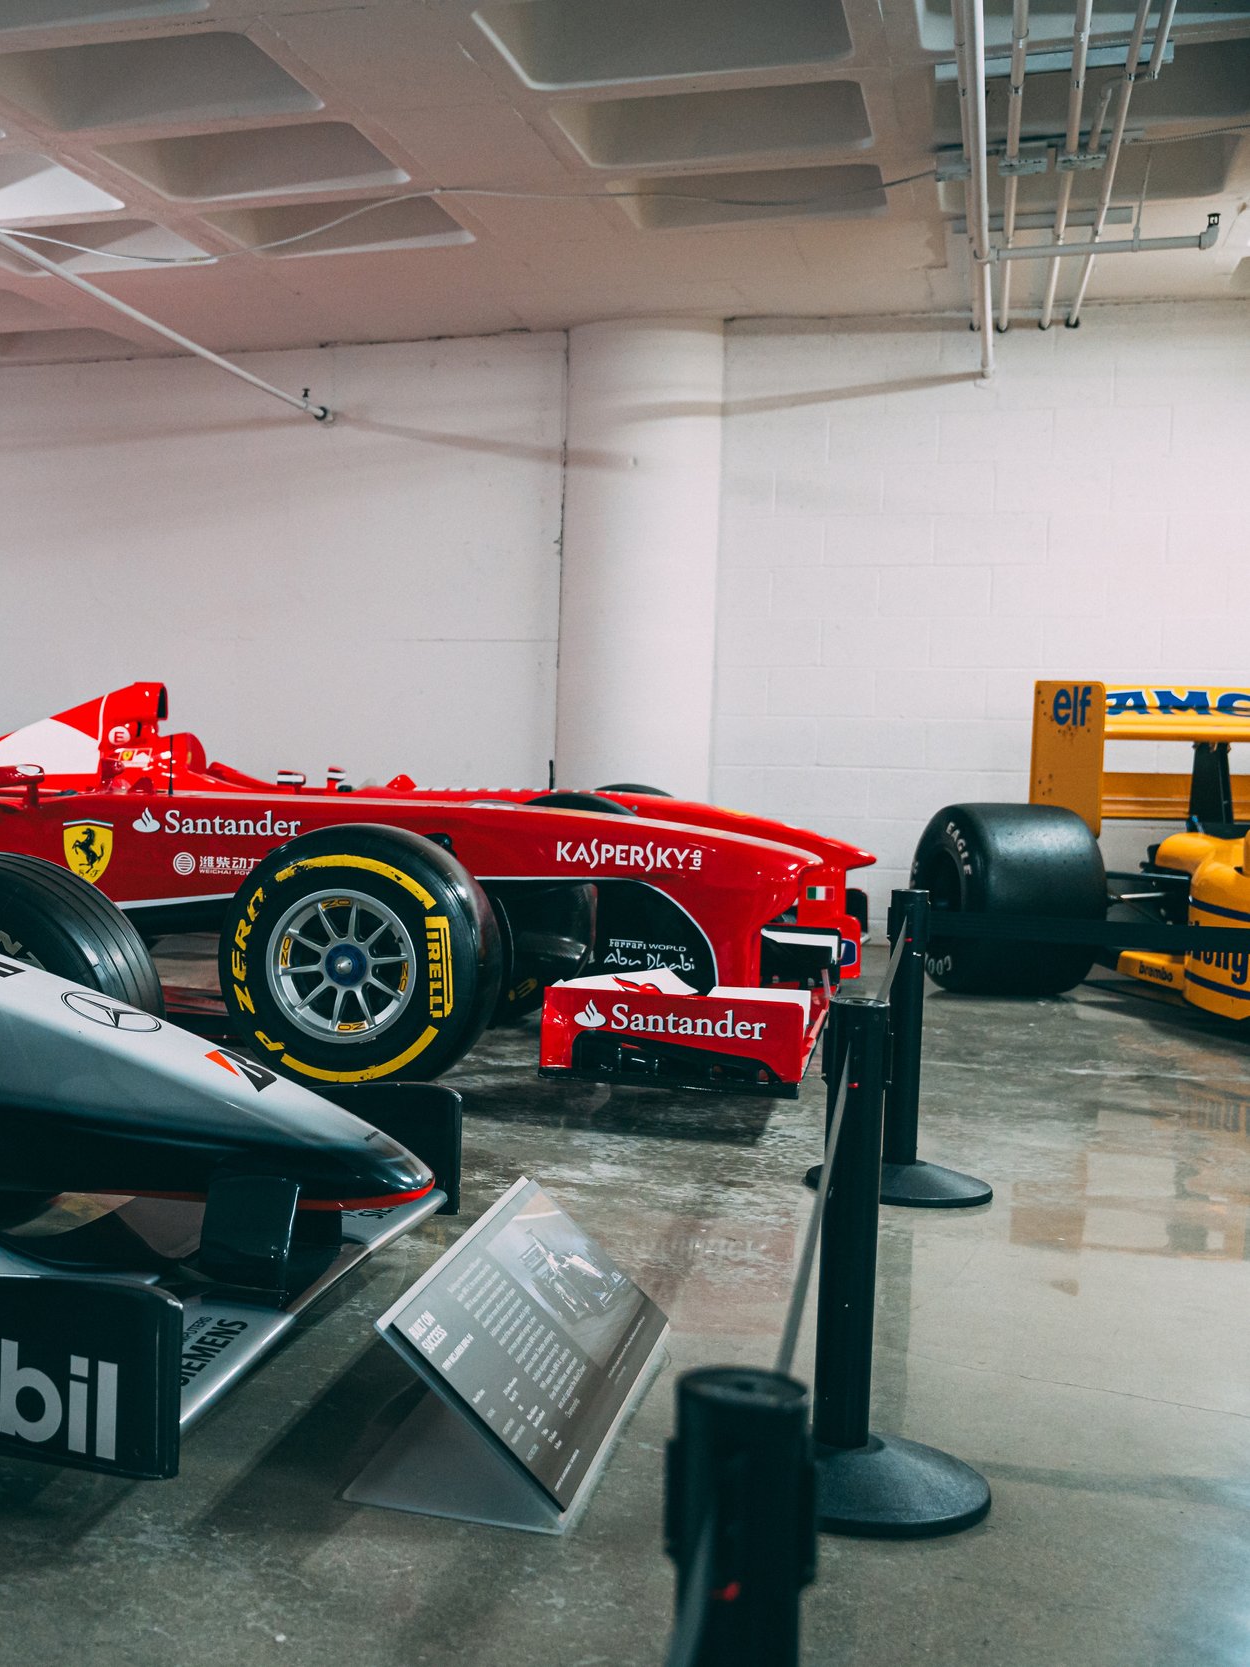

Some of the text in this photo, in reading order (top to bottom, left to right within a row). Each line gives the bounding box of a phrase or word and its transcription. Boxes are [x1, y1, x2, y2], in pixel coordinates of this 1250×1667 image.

[1053, 686, 1092, 726] elf
[114, 731, 125, 742] E
[164, 809, 301, 837] Santander
[556, 838, 691, 872] KASPERSKY
[945, 821, 973, 876] EAGLE
[604, 948, 696, 971] Abu Dhabi
[609, 938, 687, 952] Ferrari WORLD
[425, 916, 454, 1018] PIRELLI
[1138, 961, 1174, 982] brembo
[610, 1003, 766, 1040] Santander
[399, 1323, 447, 1355] SUCCESS
